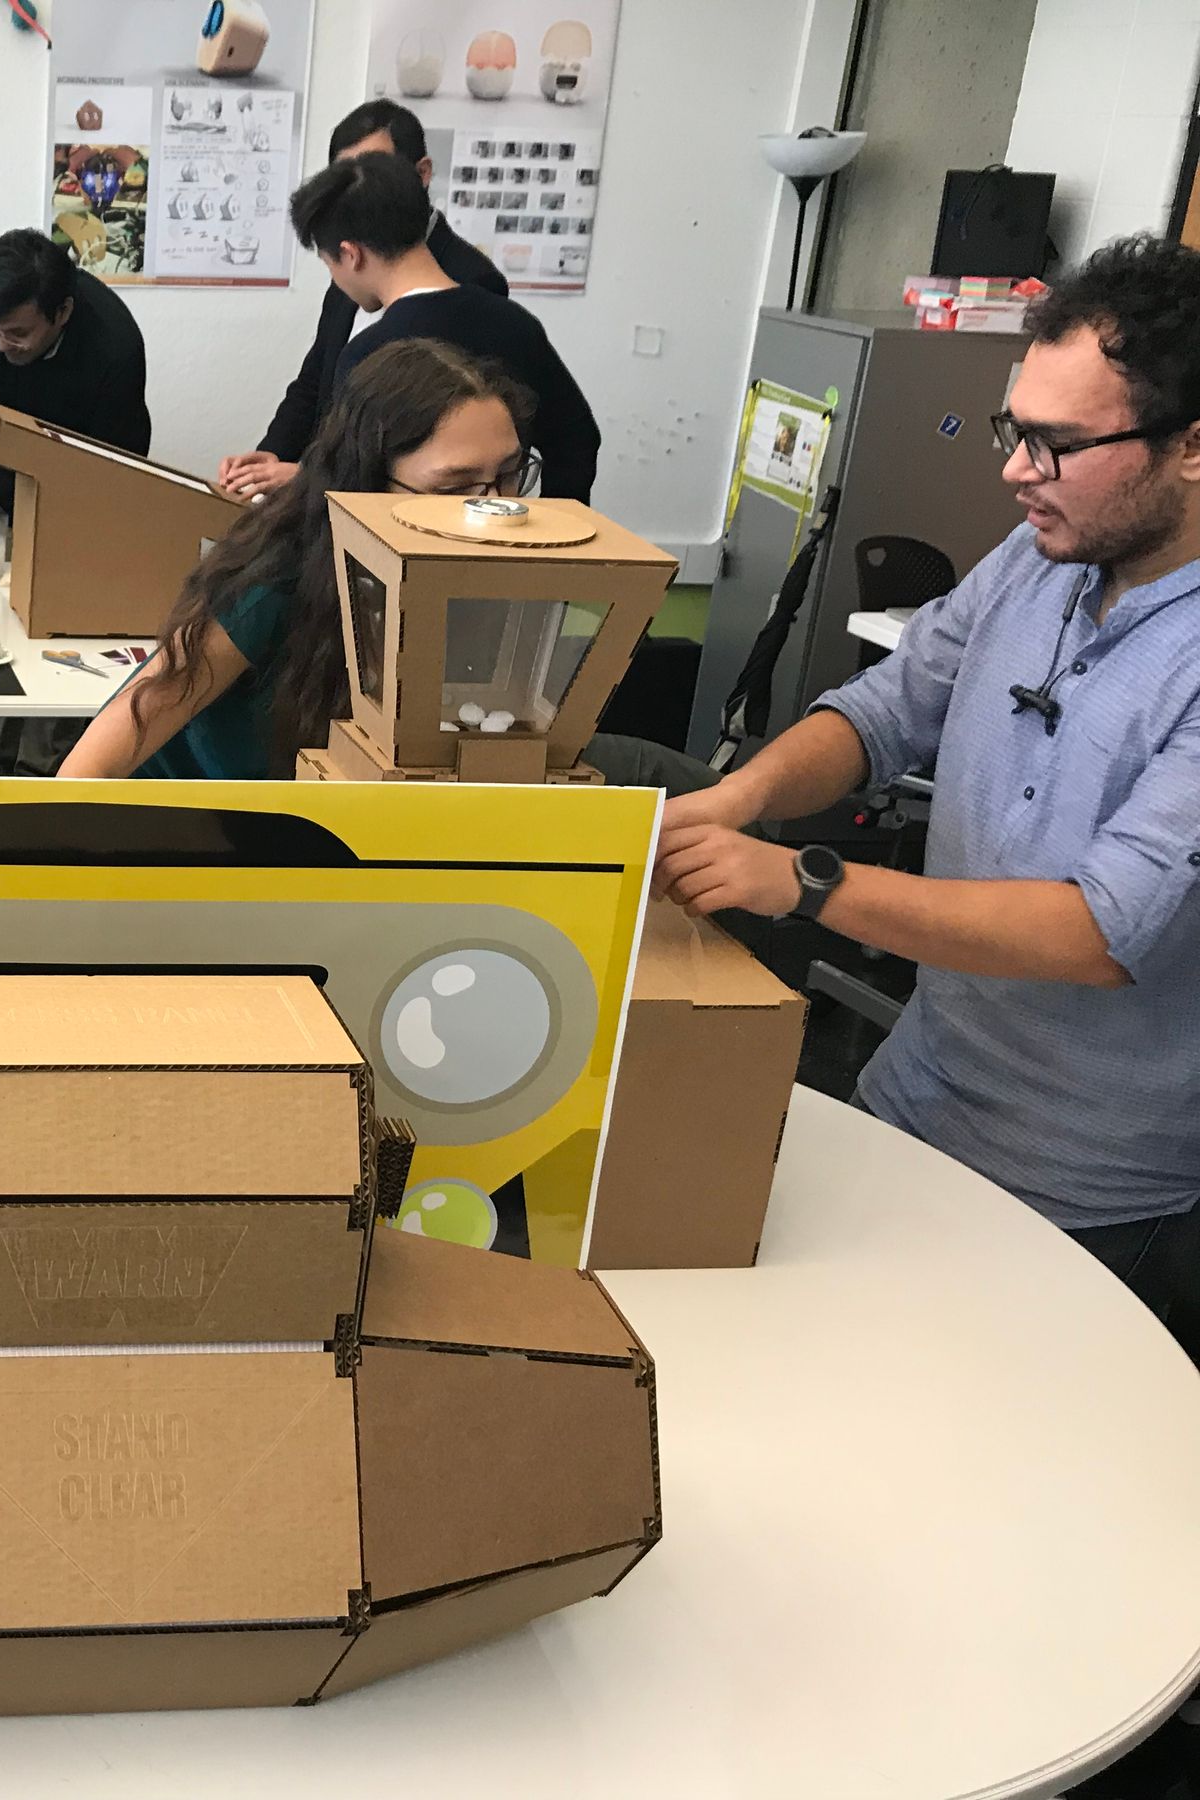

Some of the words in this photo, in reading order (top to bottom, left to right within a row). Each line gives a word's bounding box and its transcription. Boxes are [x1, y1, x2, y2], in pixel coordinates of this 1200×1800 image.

[33, 1257, 205, 1299] WARN
[53, 1412, 190, 1462] STAND
[58, 1471, 188, 1522] CLEAR
